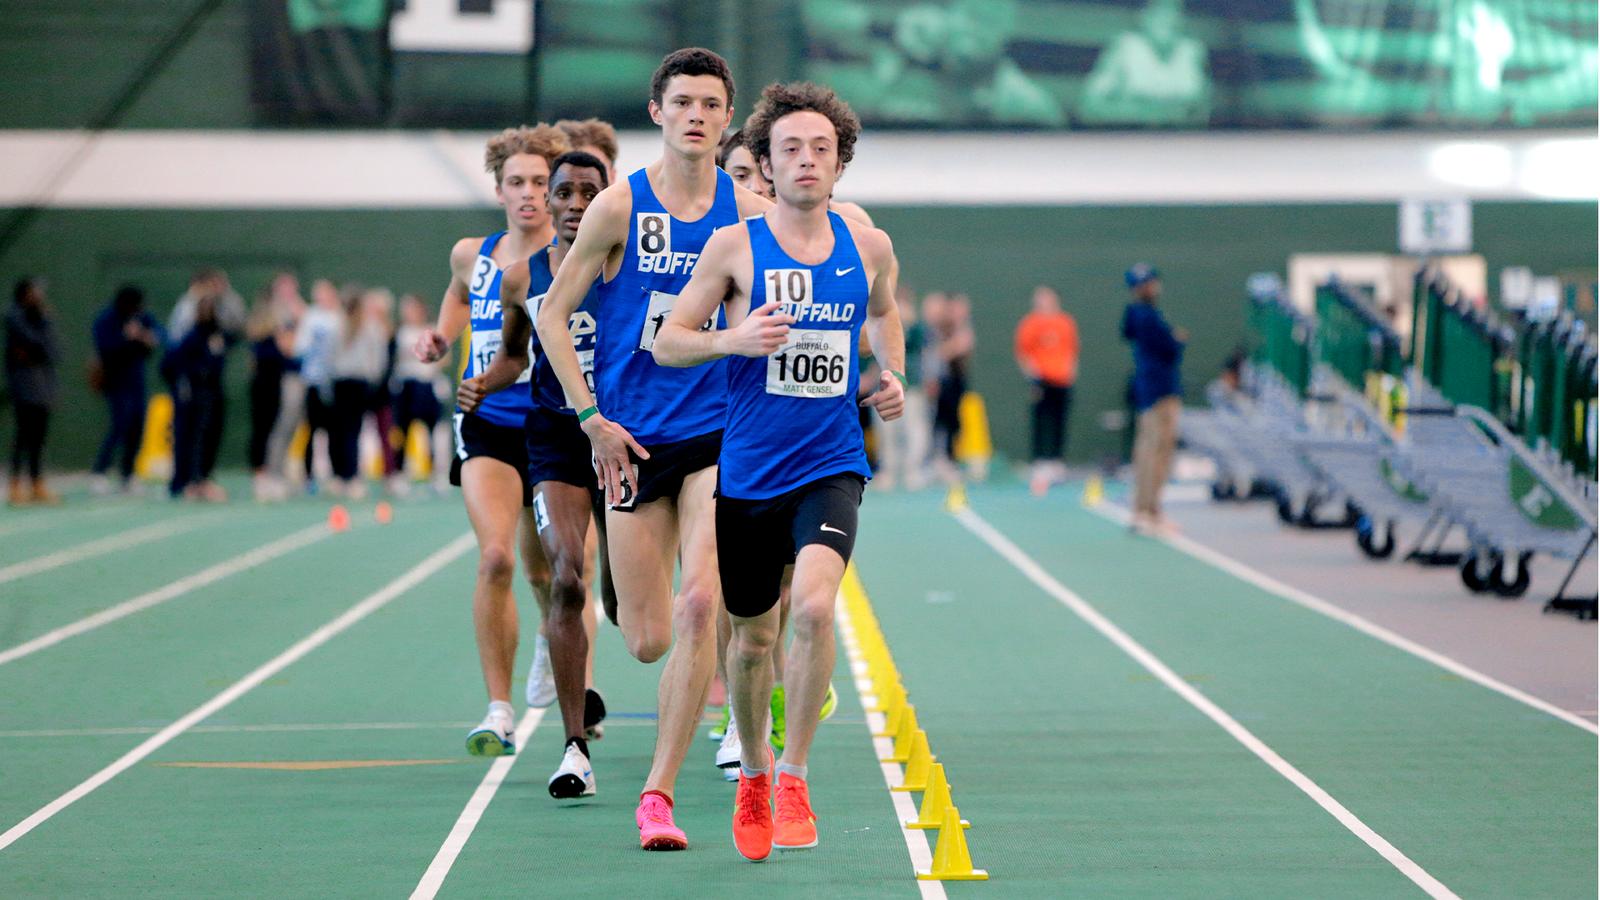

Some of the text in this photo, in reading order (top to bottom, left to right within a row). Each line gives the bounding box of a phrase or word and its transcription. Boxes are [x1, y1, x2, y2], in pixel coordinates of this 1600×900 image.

[641, 216, 665, 254] 8
[472, 260, 492, 292] 3
[638, 251, 700, 275] BUFF
[768, 271, 806, 302] 10
[471, 299, 504, 320] BUF
[795, 342, 829, 351] BUFFALO
[774, 353, 844, 383] 1066
[783, 384, 834, 394] MATT GENSEL
